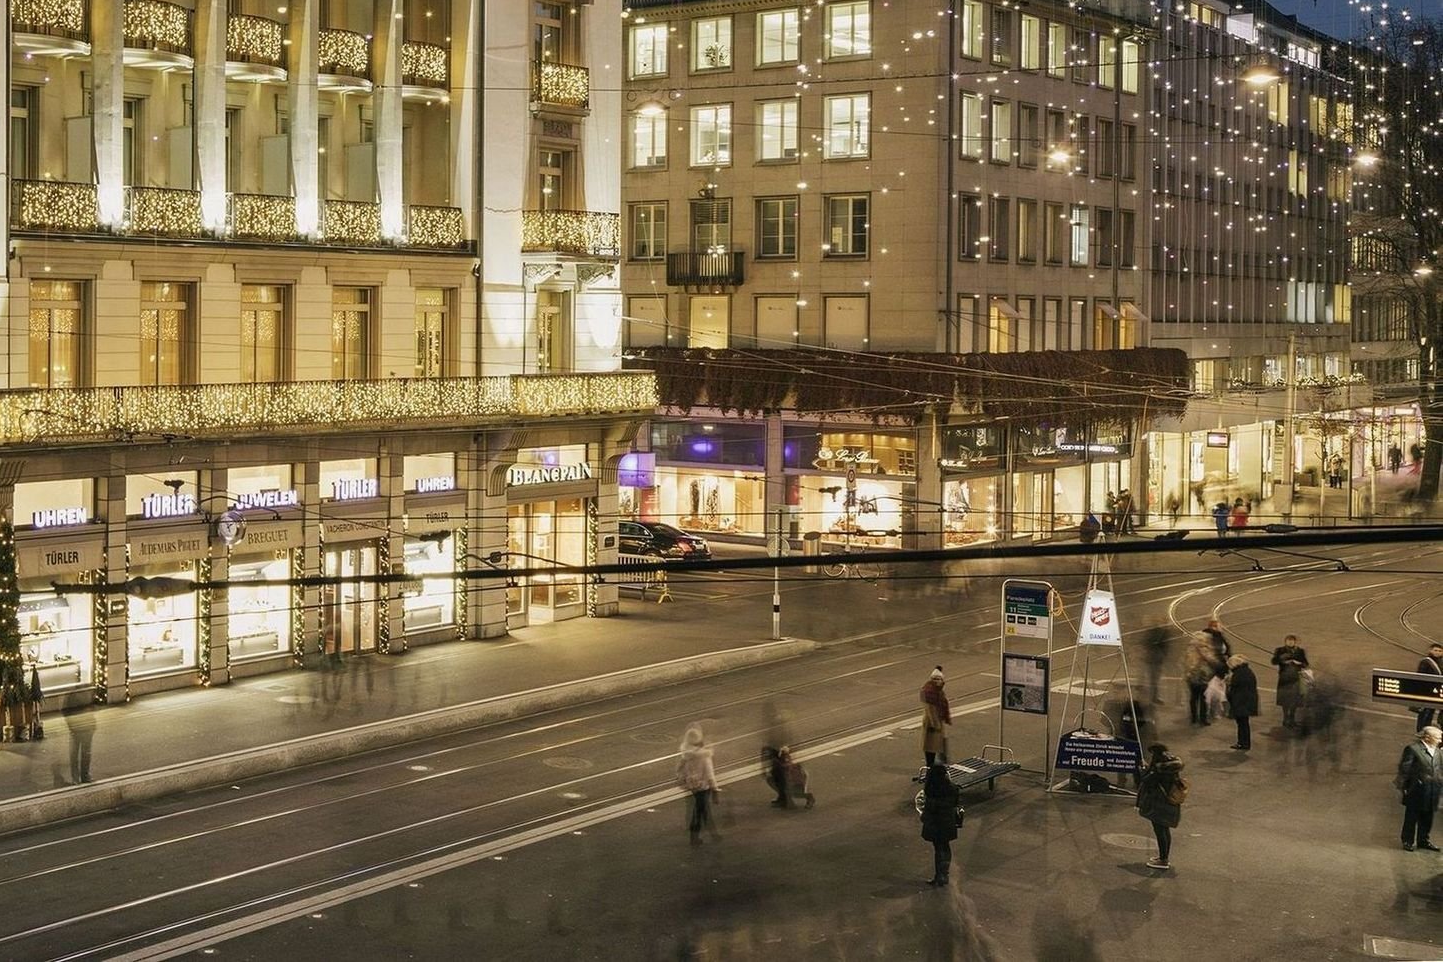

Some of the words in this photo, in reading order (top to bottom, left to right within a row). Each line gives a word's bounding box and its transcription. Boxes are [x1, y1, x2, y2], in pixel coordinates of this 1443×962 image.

[334, 478, 378, 501] TÜRLER
[415, 477, 455, 493] UHREN
[142, 493, 196, 518] TÜRLER
[236, 490, 298, 510] JUWELEN
[32, 507, 88, 529] UHREN
[426, 511, 449, 524] TÜRLER
[247, 529, 289, 545] BREGUET
[139, 541, 177, 556] AUDEMARS
[177, 539, 201, 553] PIGUET
[45, 550, 79, 566] TÜRLER
[1071, 755, 1105, 767] Freude
